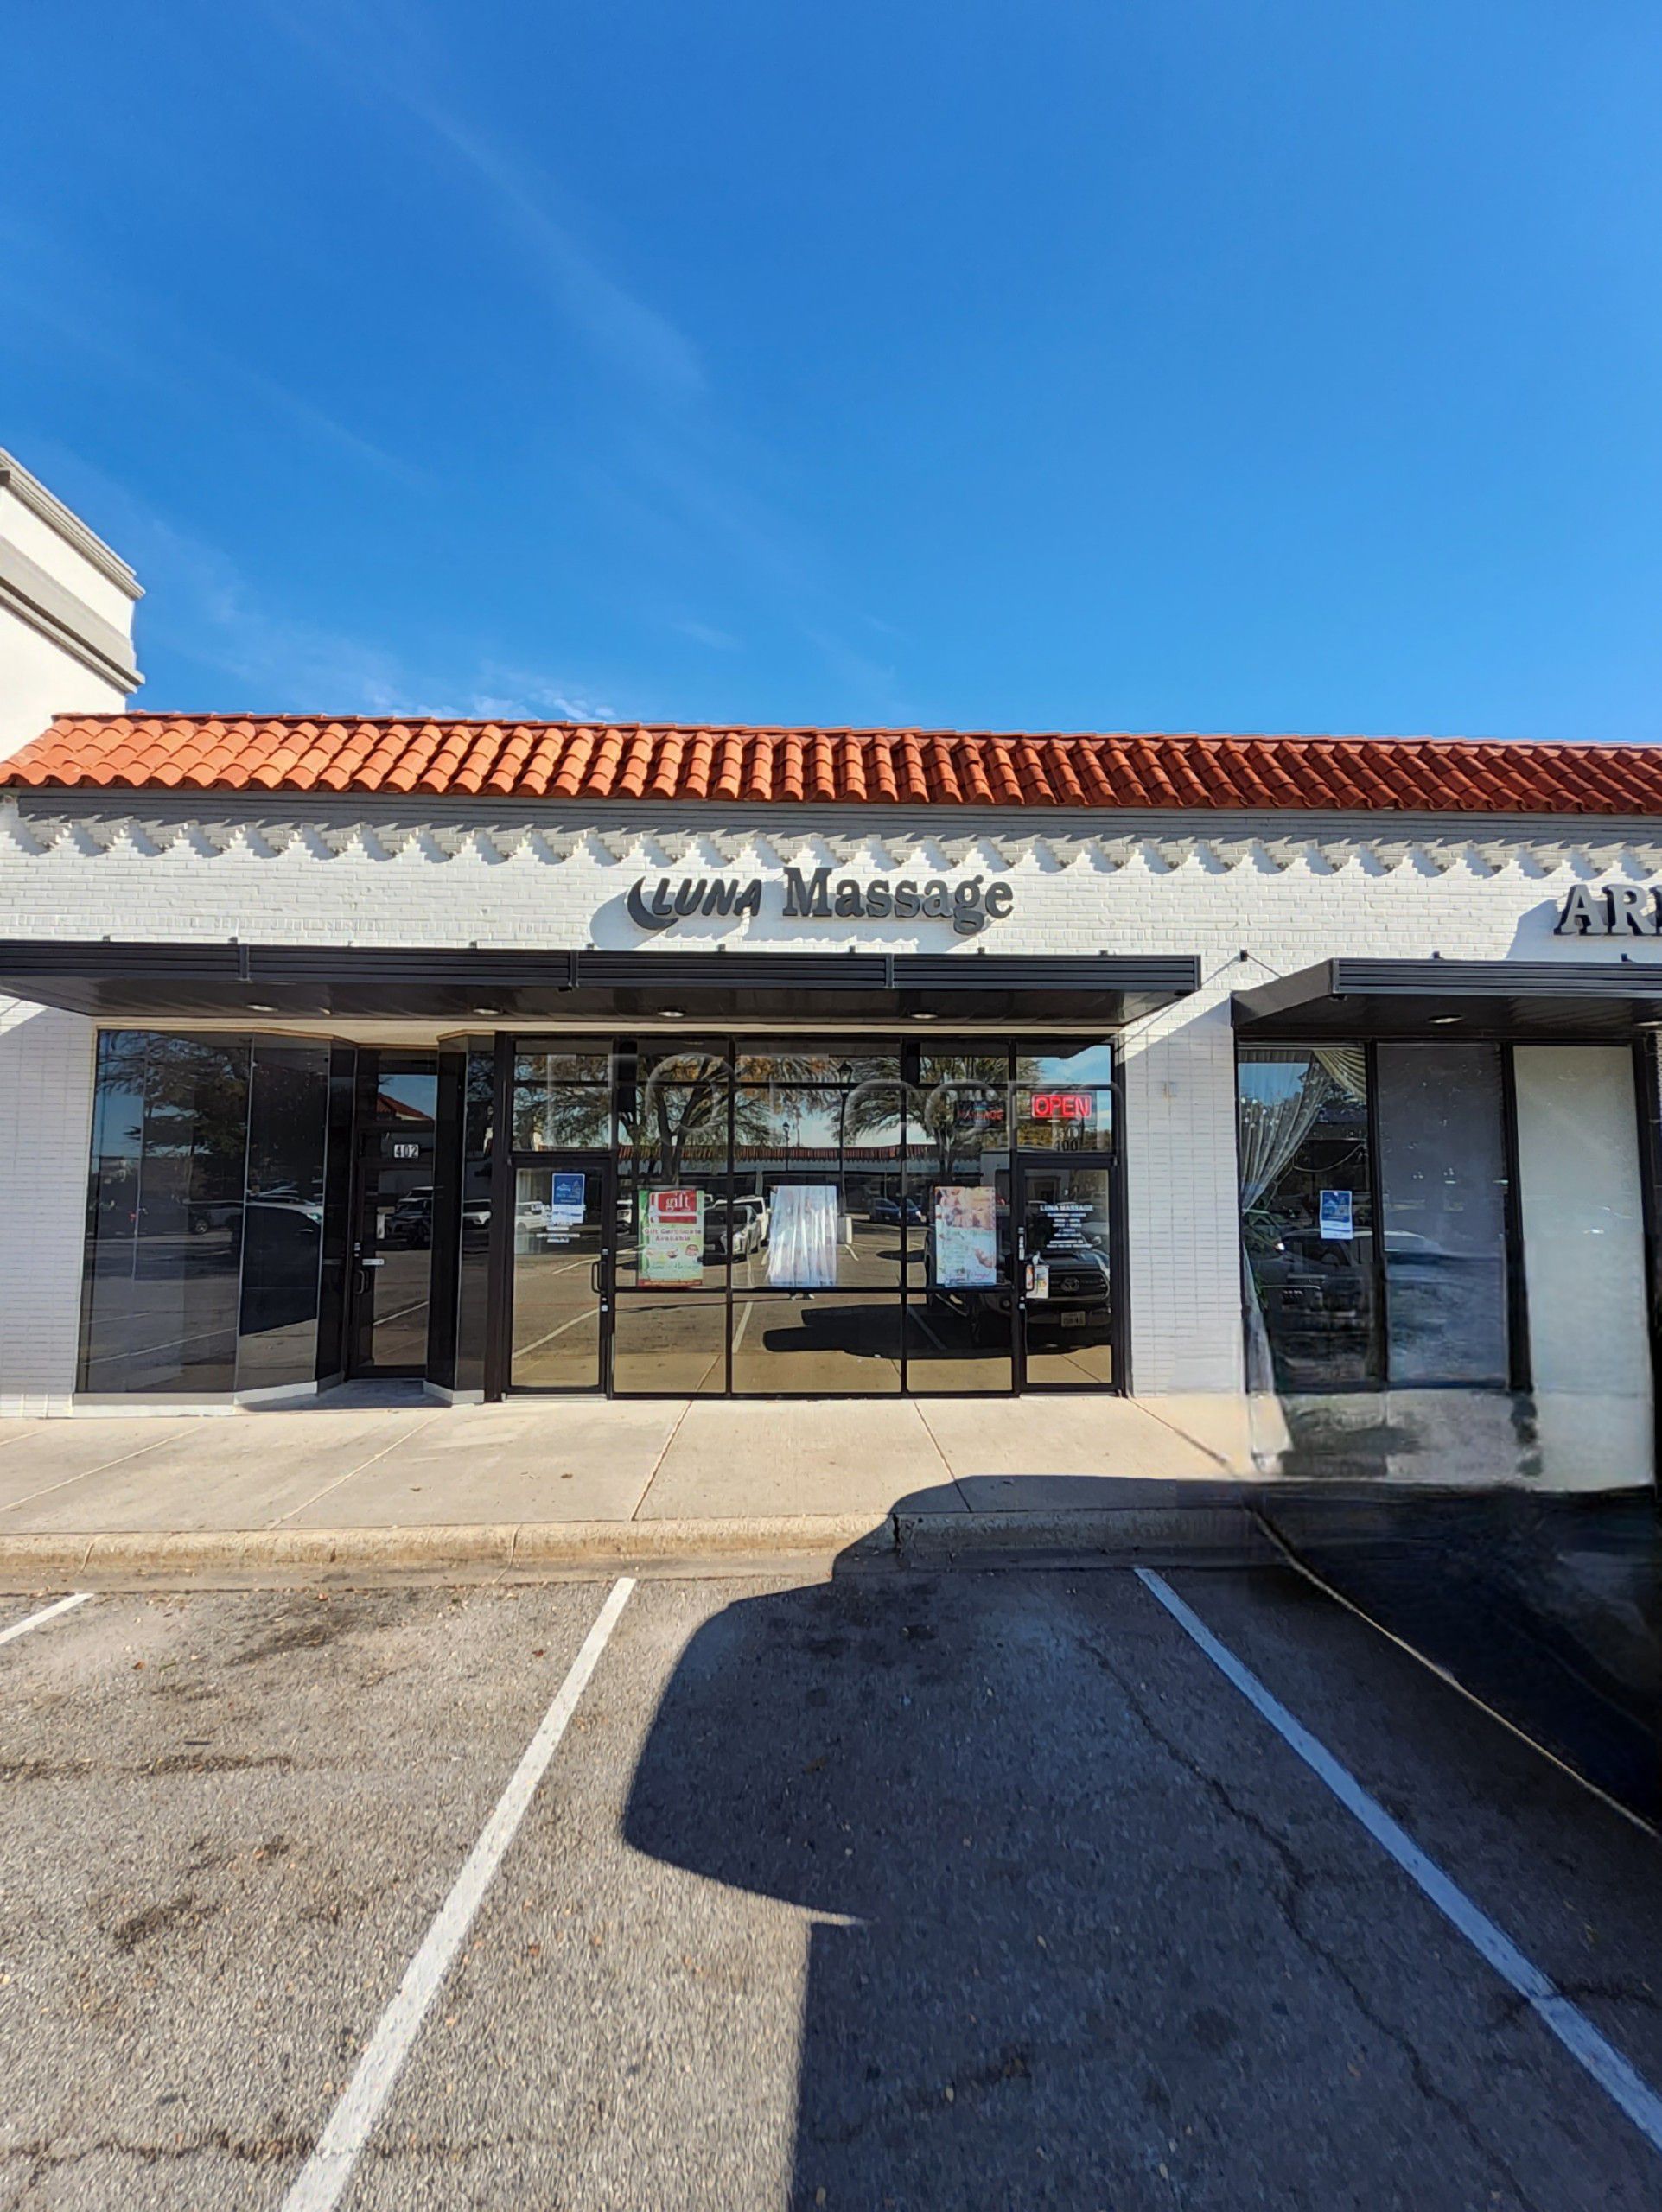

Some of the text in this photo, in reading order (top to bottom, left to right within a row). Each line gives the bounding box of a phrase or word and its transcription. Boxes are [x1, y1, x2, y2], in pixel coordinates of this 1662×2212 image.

[651, 867, 1013, 935] LUNA Massage
[1553, 883, 1662, 936] AR
[1035, 1096, 1089, 1118] OPEN
[395, 1144, 418, 1157] 402
[666, 1192, 691, 1212] gift
